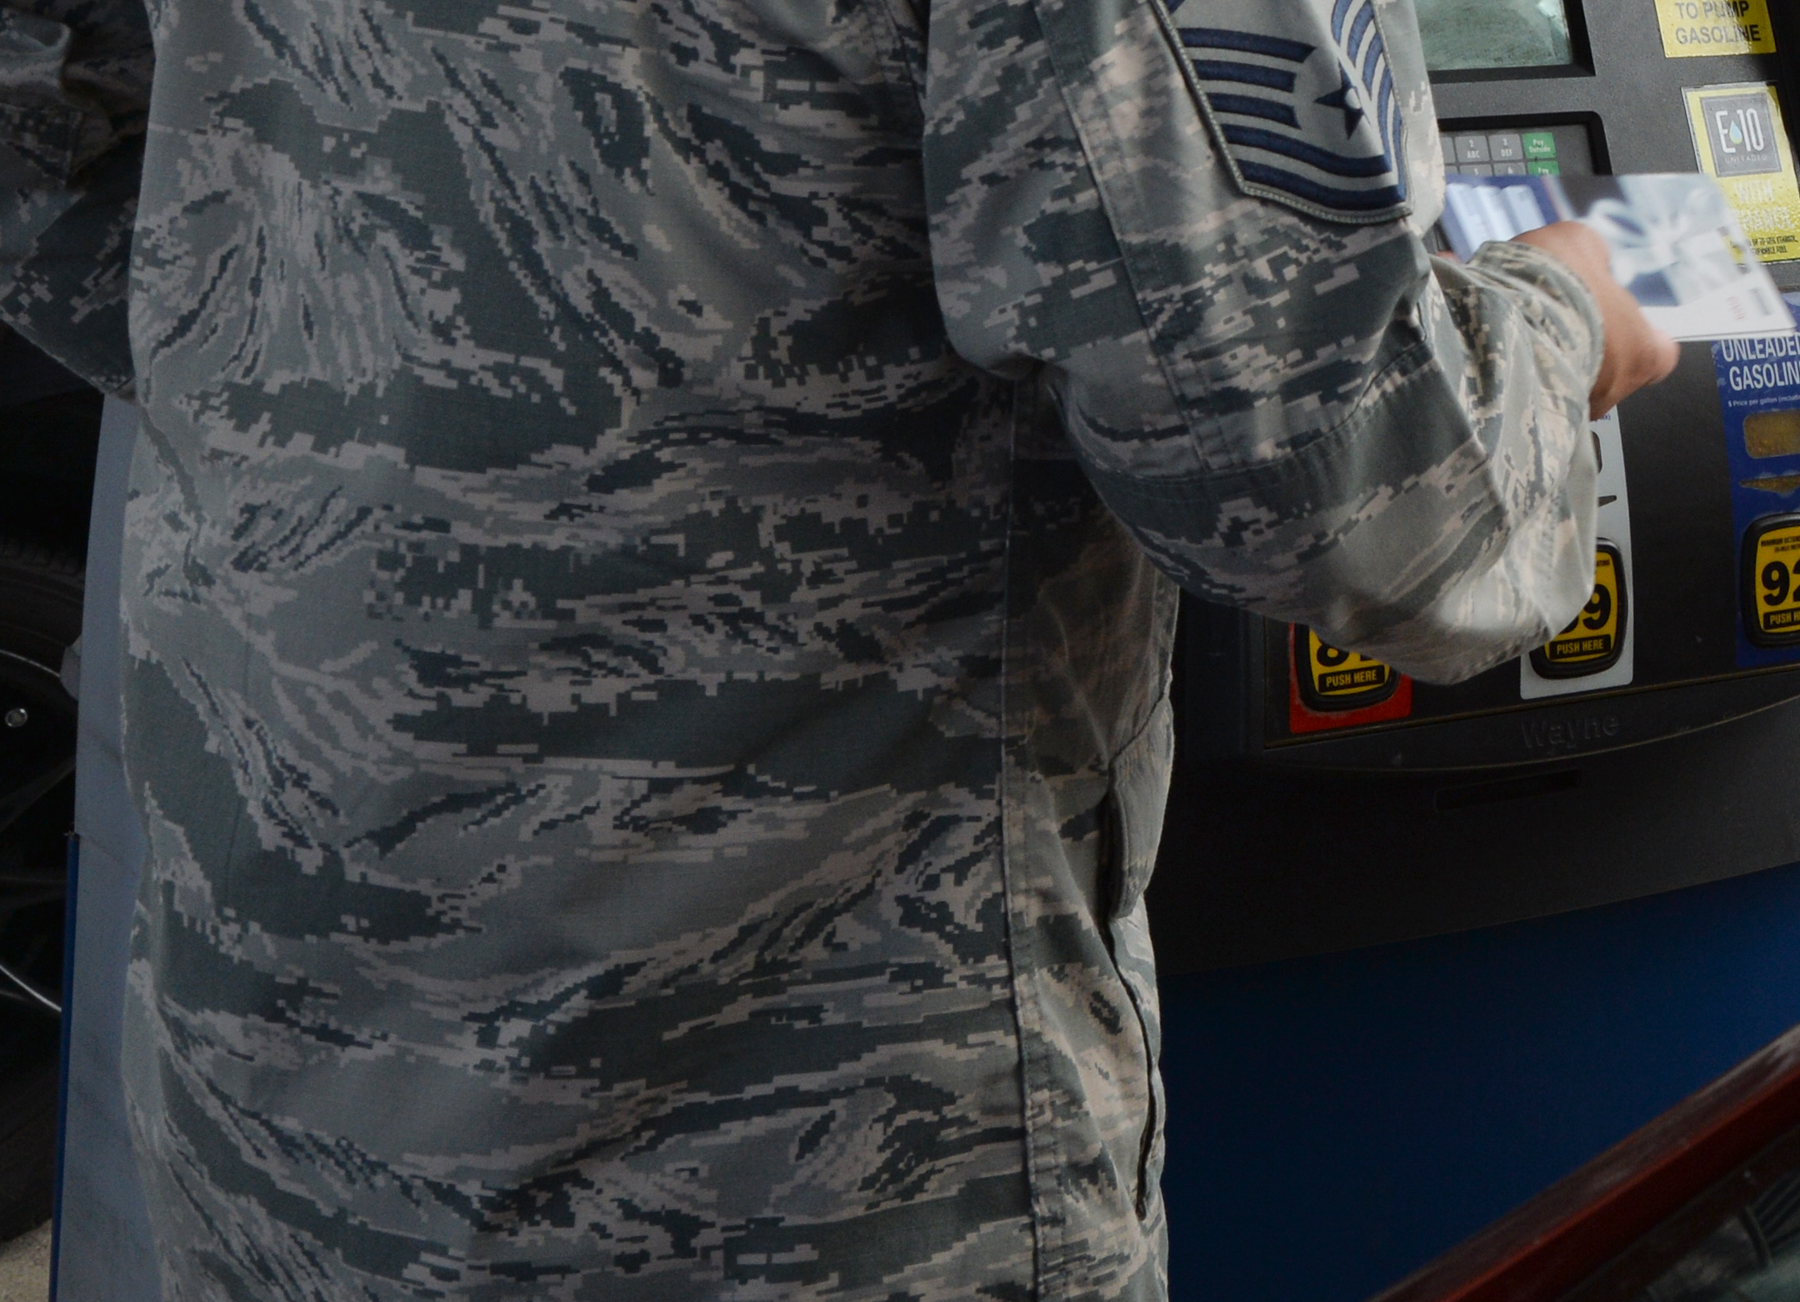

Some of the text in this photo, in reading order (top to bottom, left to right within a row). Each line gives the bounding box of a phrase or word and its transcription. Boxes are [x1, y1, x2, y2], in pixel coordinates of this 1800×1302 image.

[1675, 0, 1749, 19] TO PUMP
[1675, 24, 1762, 45] GASOLINE
[1469, 140, 1474, 148] 2
[1502, 138, 1508, 146] 3
[1467, 150, 1480, 159] ABC
[1501, 149, 1513, 157] DEF
[1760, 397, 1777, 405] gallon
[1770, 612, 1792, 625] PUSH
[1557, 638, 1604, 655] PUSH HERE
[1326, 669, 1377, 688] PUSH HERE
